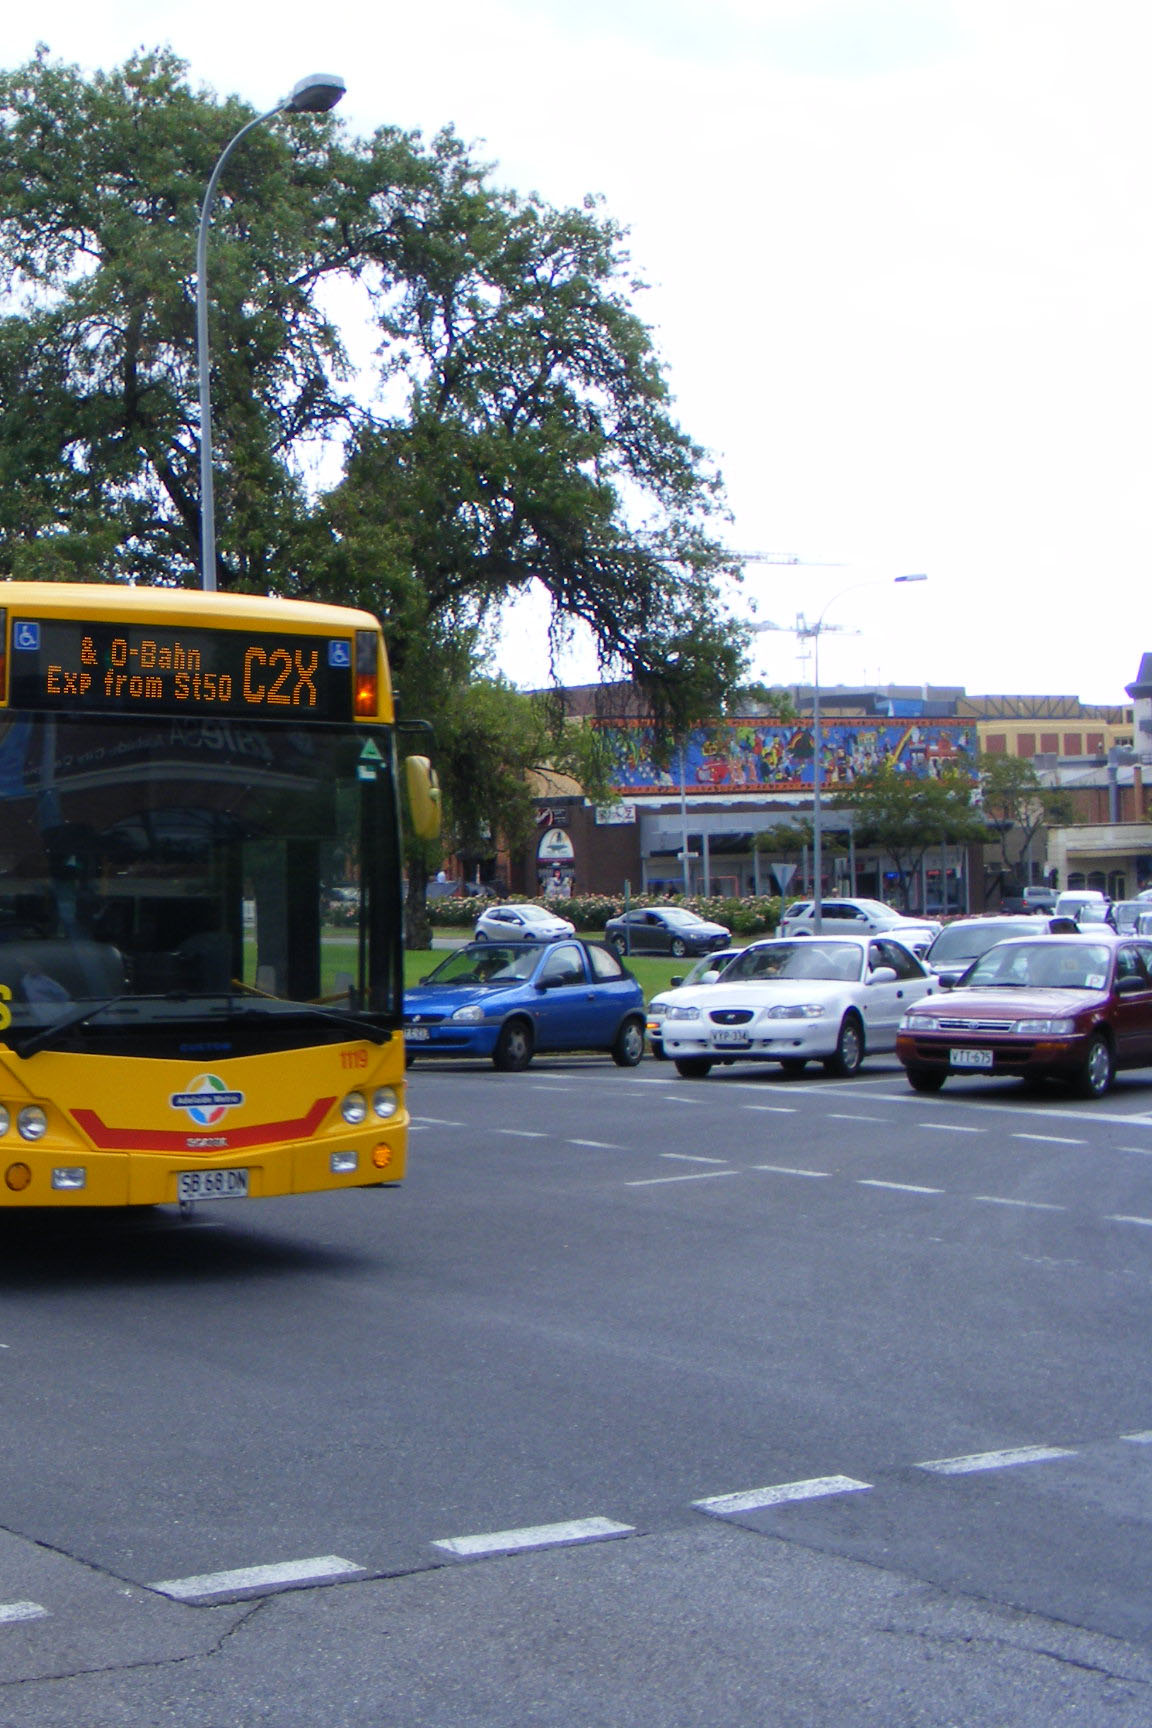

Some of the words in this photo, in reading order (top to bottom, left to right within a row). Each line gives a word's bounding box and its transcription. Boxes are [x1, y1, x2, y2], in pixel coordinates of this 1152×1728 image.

[81, 636, 98, 665] &
[111, 638, 201, 671] O-Bahn
[47, 665, 92, 695] Exp
[104, 668, 163, 698] from
[174, 672, 232, 702] St50
[243, 646, 319, 706] C2X
[340, 1050, 368, 1069] 1119
